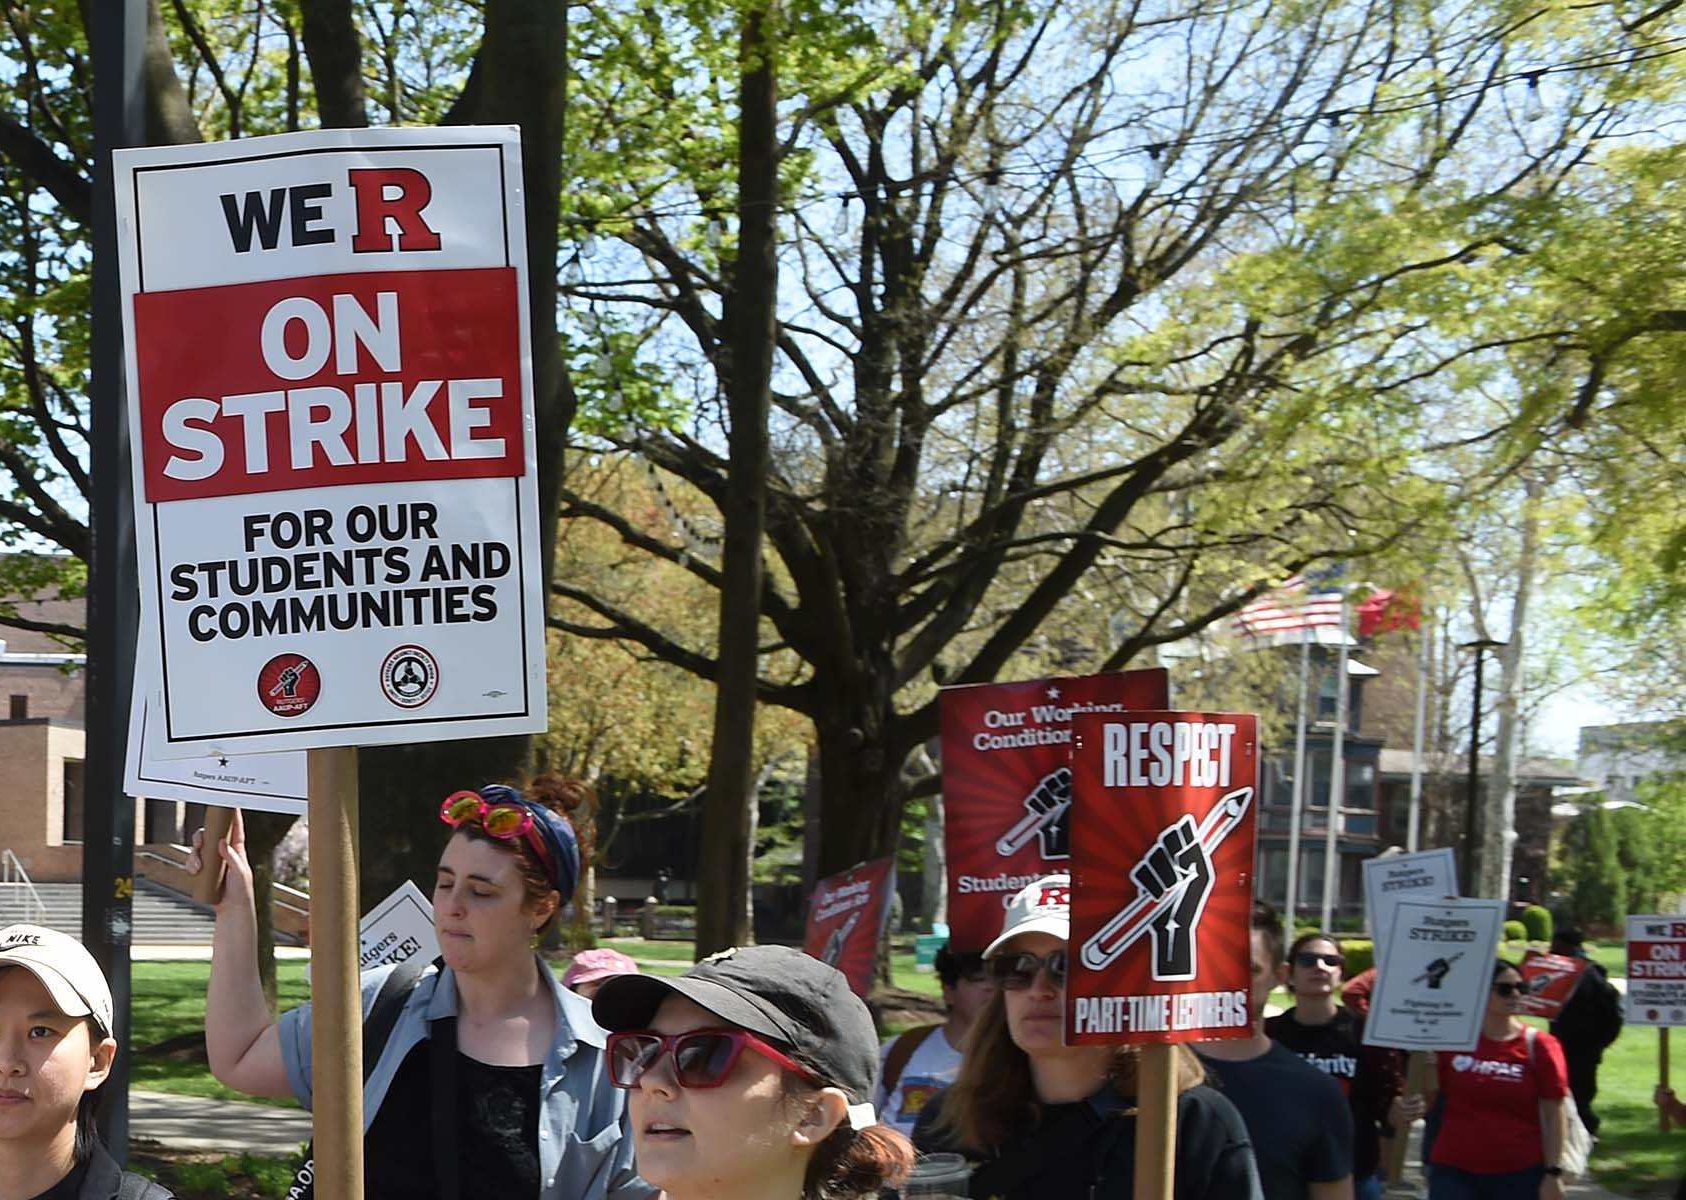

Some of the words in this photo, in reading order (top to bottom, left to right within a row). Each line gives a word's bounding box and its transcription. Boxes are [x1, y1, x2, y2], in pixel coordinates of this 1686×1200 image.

[219, 182, 336, 254] WE
[348, 166, 443, 254] R
[260, 291, 403, 381] ON
[161, 377, 508, 482] STRIKE
[242, 508, 335, 553] FOR
[345, 501, 439, 544] OUR
[169, 546, 411, 602] STUDENTS
[418, 541, 512, 583] AND
[187, 584, 499, 643] COMMUNITIES
[983, 710, 1027, 729] Our
[1102, 721, 1236, 788] RESPECT
[1034, 887, 1070, 906] R
[5, 933, 41, 945] NIKE
[1650, 943, 1680, 961] ON
[1074, 995, 1171, 1034] PART-TIME
